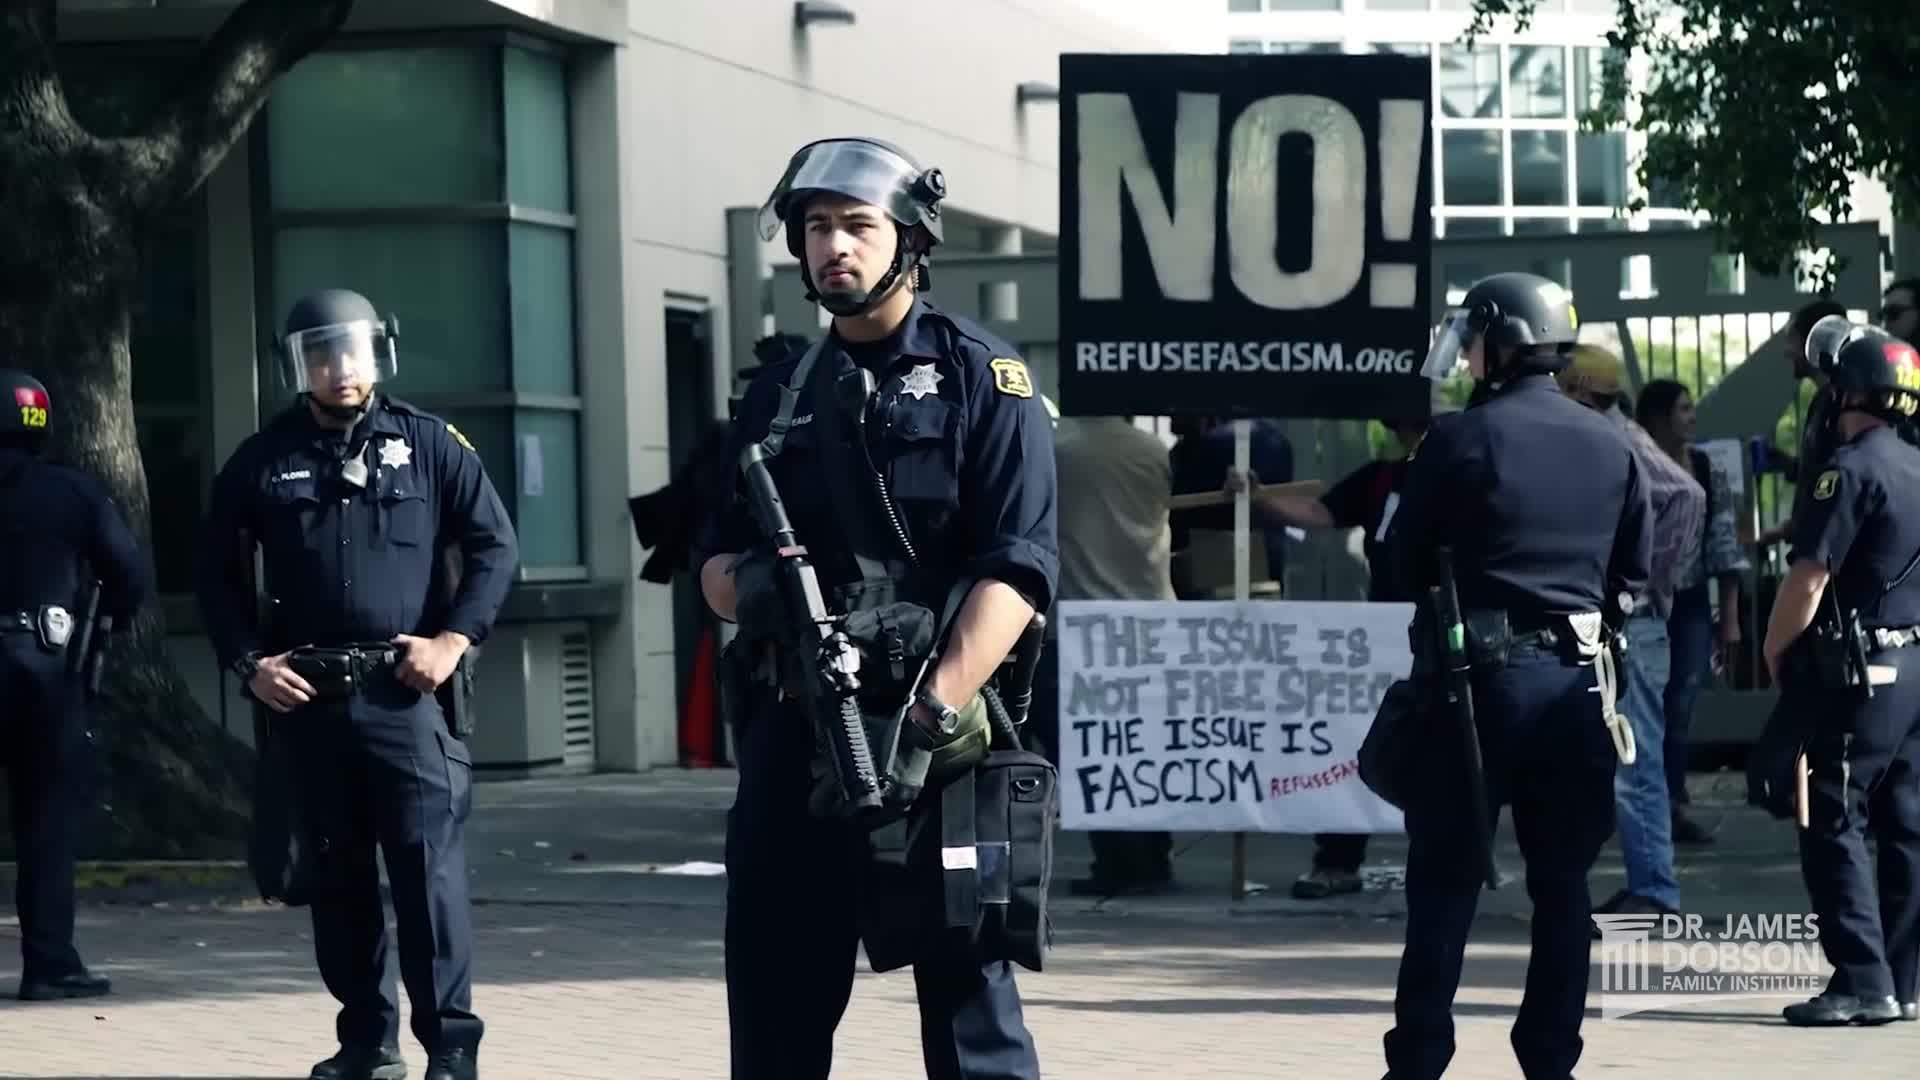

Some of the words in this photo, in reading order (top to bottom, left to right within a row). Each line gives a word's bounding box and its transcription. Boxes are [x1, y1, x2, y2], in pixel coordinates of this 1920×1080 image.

[1077, 91, 1424, 310] NO!
[1076, 341, 1414, 373] REFUSEFASCISM.ORG
[21, 406, 47, 427] 129
[1065, 614, 1166, 668] THE
[1177, 616, 1298, 666] ISSUE
[1318, 627, 1371, 668] IS
[1067, 671, 1150, 716] NOT
[1163, 669, 1266, 716] FREE
[1073, 718, 1144, 757] THE
[1164, 716, 1267, 752] ISSUE
[1280, 720, 1333, 756] IS
[1076, 758, 1264, 815] FASCISM
